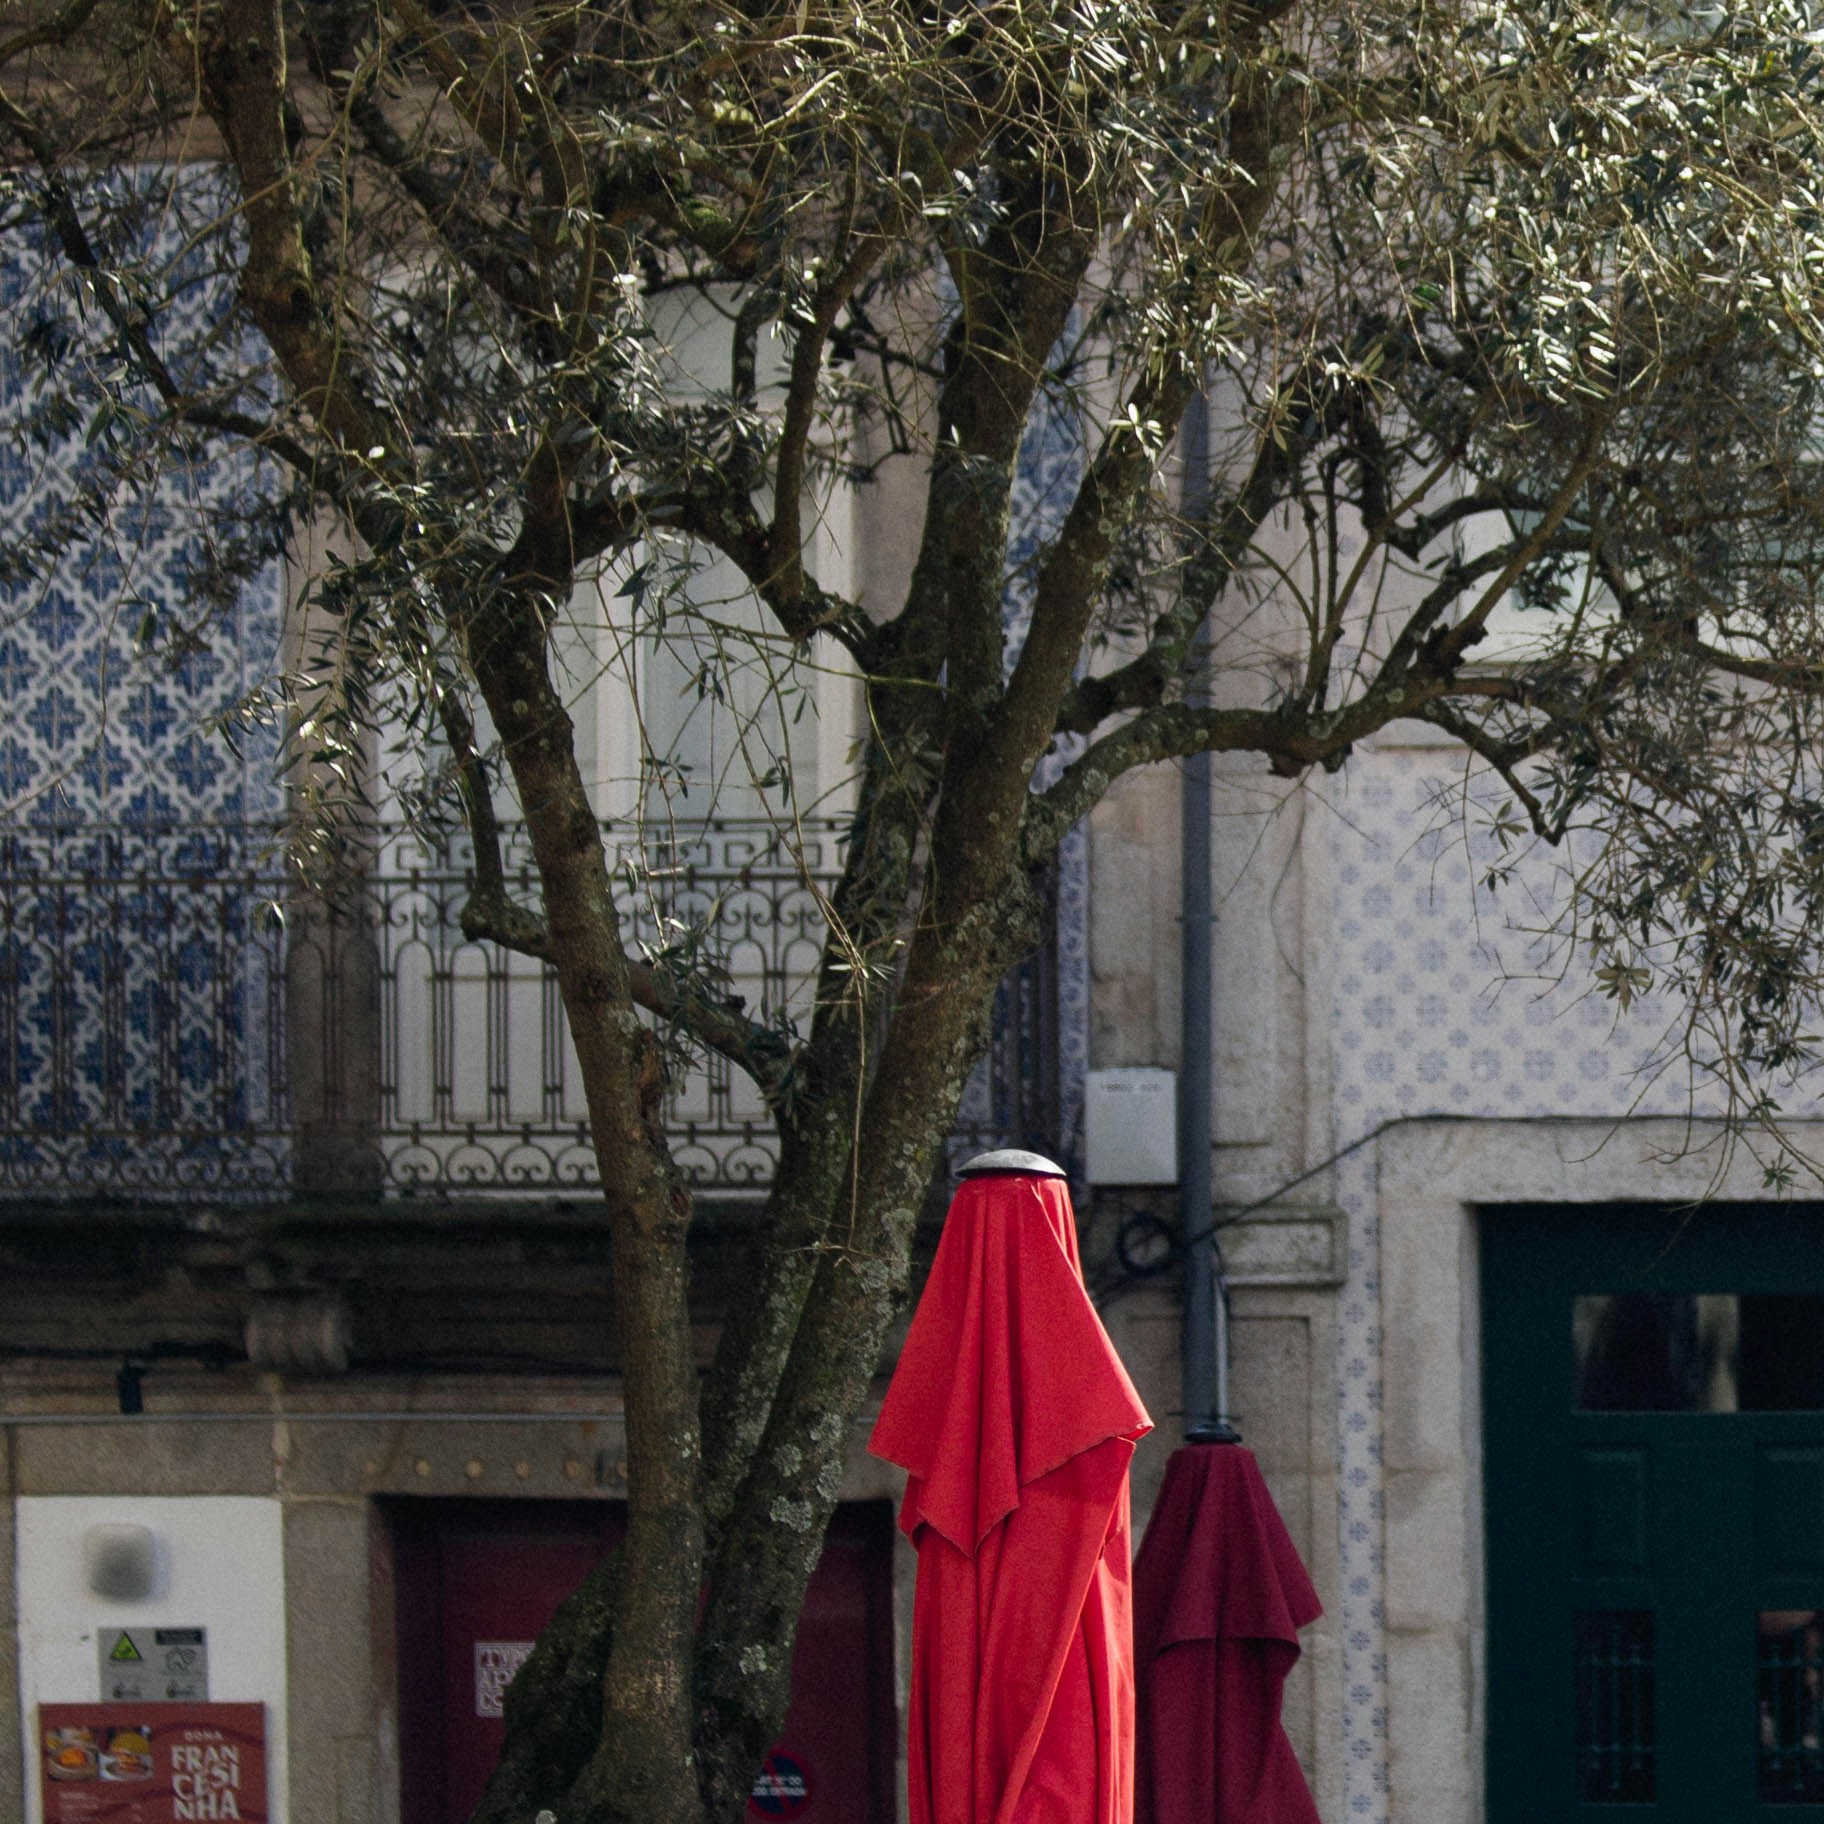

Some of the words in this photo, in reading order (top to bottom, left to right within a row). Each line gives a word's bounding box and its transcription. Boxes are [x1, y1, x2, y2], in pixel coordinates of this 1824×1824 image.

[171, 1744, 240, 1772] FRAN
[172, 1764, 241, 1801] CESI
[173, 1790, 241, 1821] NHA
